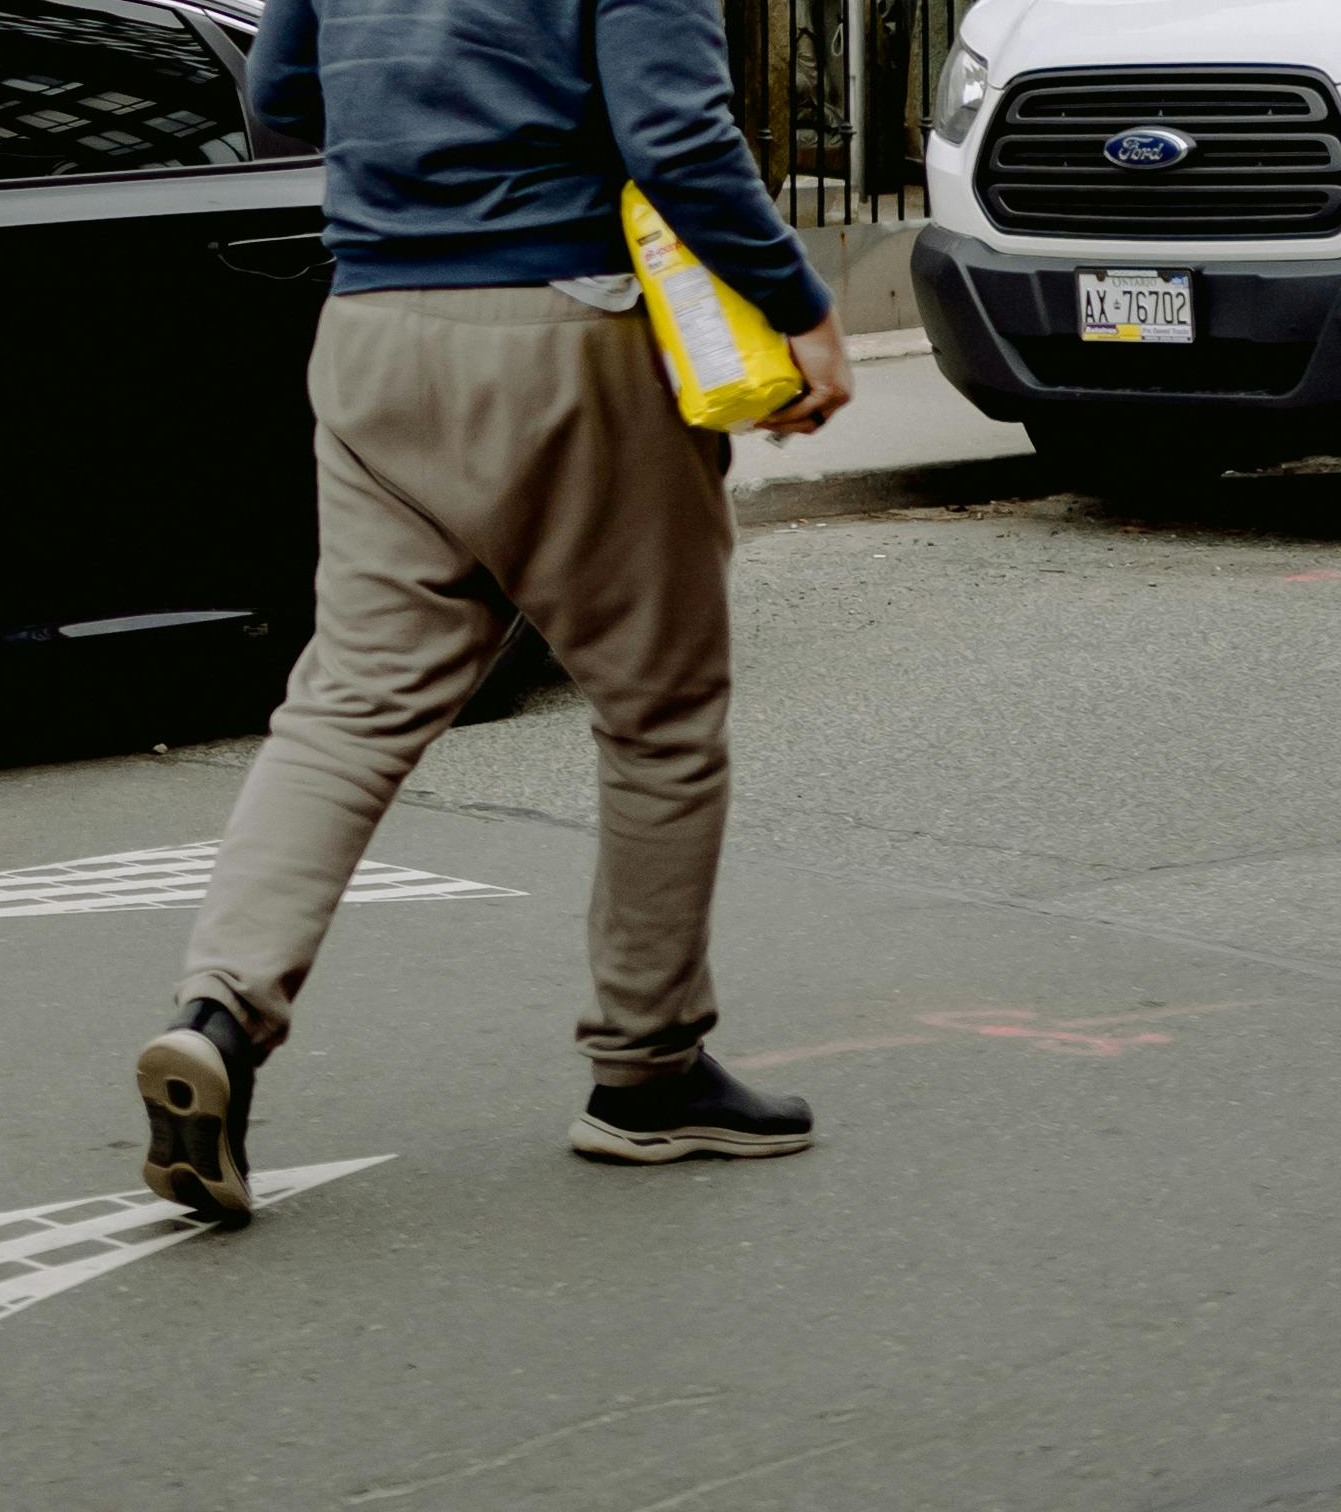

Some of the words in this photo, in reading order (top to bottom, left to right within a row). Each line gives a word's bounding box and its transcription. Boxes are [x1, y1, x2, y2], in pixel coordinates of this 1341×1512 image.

[1118, 136, 1165, 160] Ford
[1085, 290, 1109, 323] AX
[1122, 290, 1188, 324] 76702
